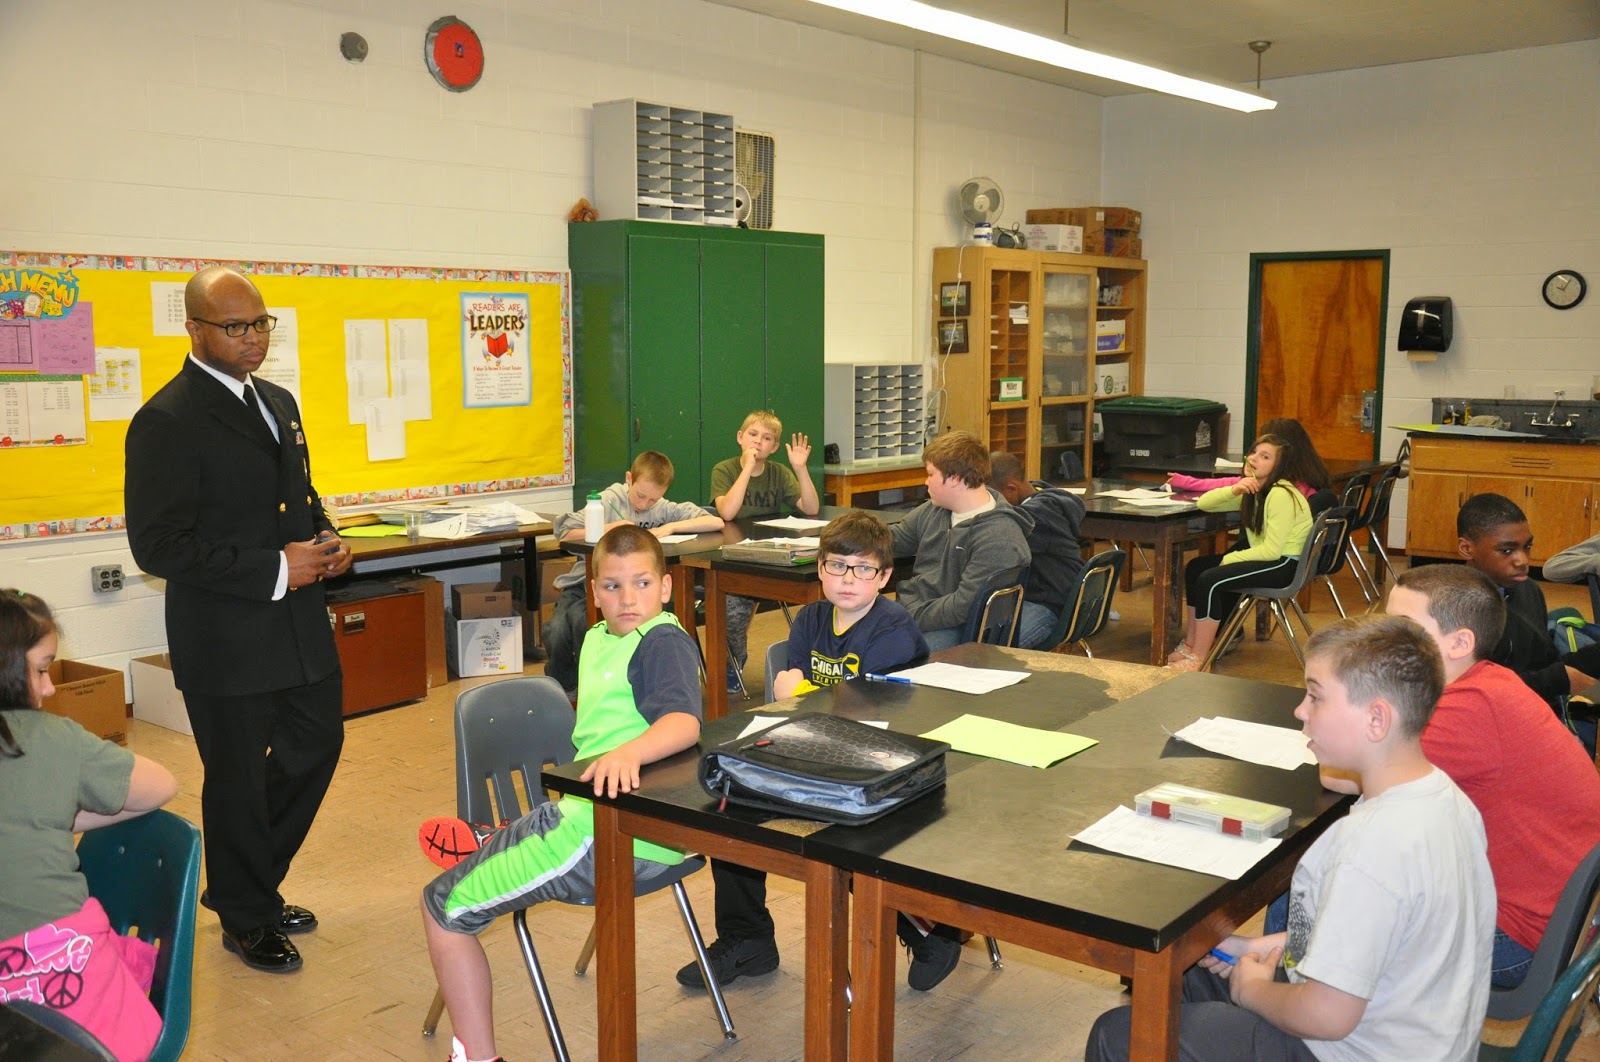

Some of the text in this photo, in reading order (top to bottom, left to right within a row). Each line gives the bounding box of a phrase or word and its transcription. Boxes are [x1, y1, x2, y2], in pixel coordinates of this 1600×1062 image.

[20, 271, 76, 308] MENU
[472, 303, 521, 312] READERS ARE
[470, 314, 525, 331] LEADERS
[743, 489, 779, 507] RMY
